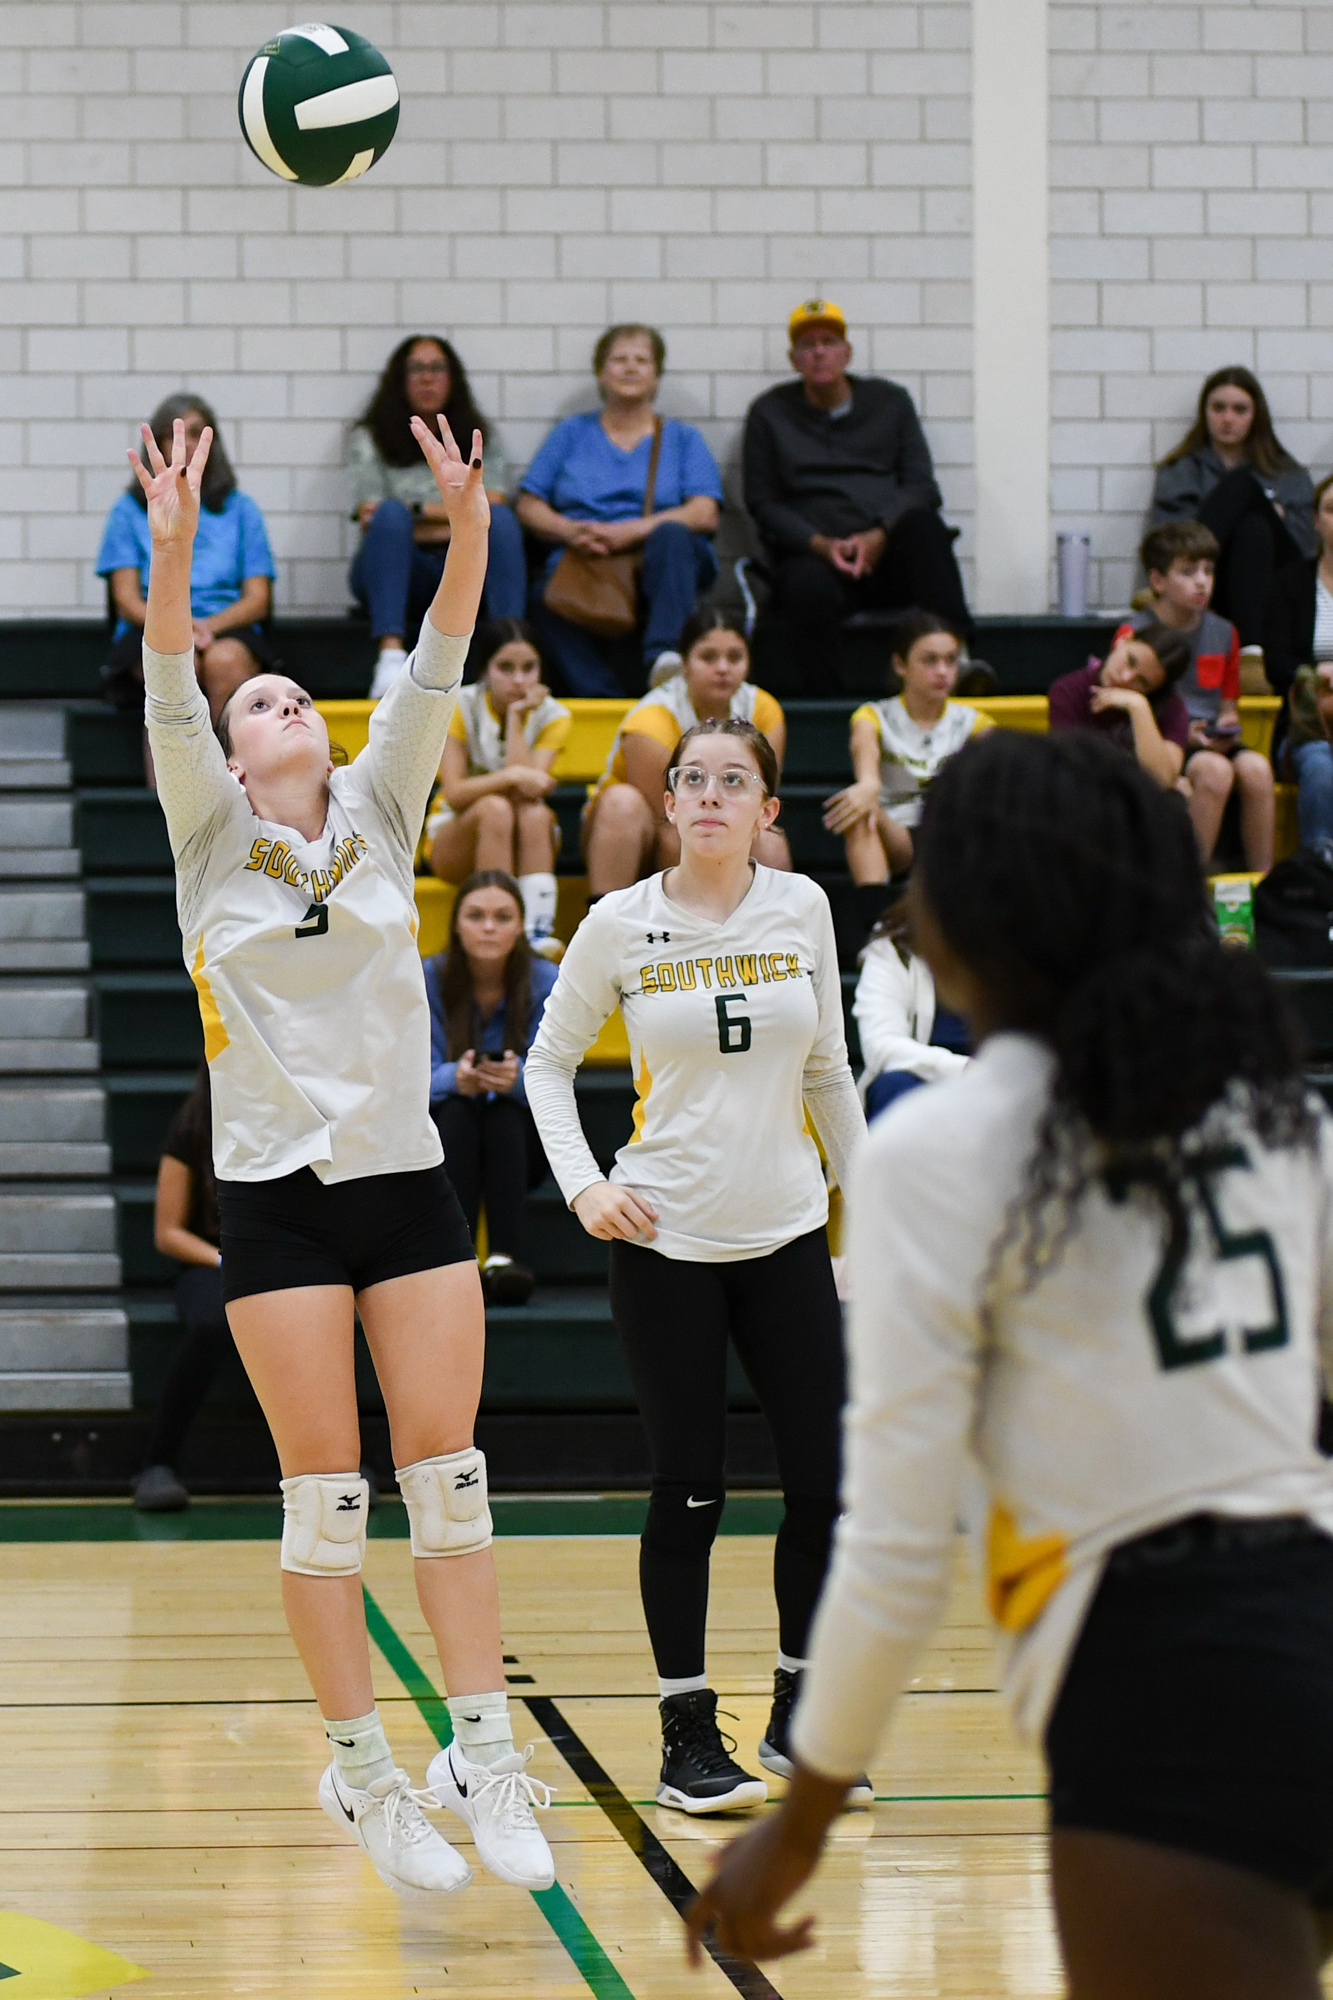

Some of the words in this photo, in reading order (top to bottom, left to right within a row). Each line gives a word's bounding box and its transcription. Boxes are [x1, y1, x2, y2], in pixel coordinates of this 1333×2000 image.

[640, 953, 803, 993] SOUTHWICK
[714, 993, 752, 1054] 6
[1106, 1144, 1290, 1371] 25
